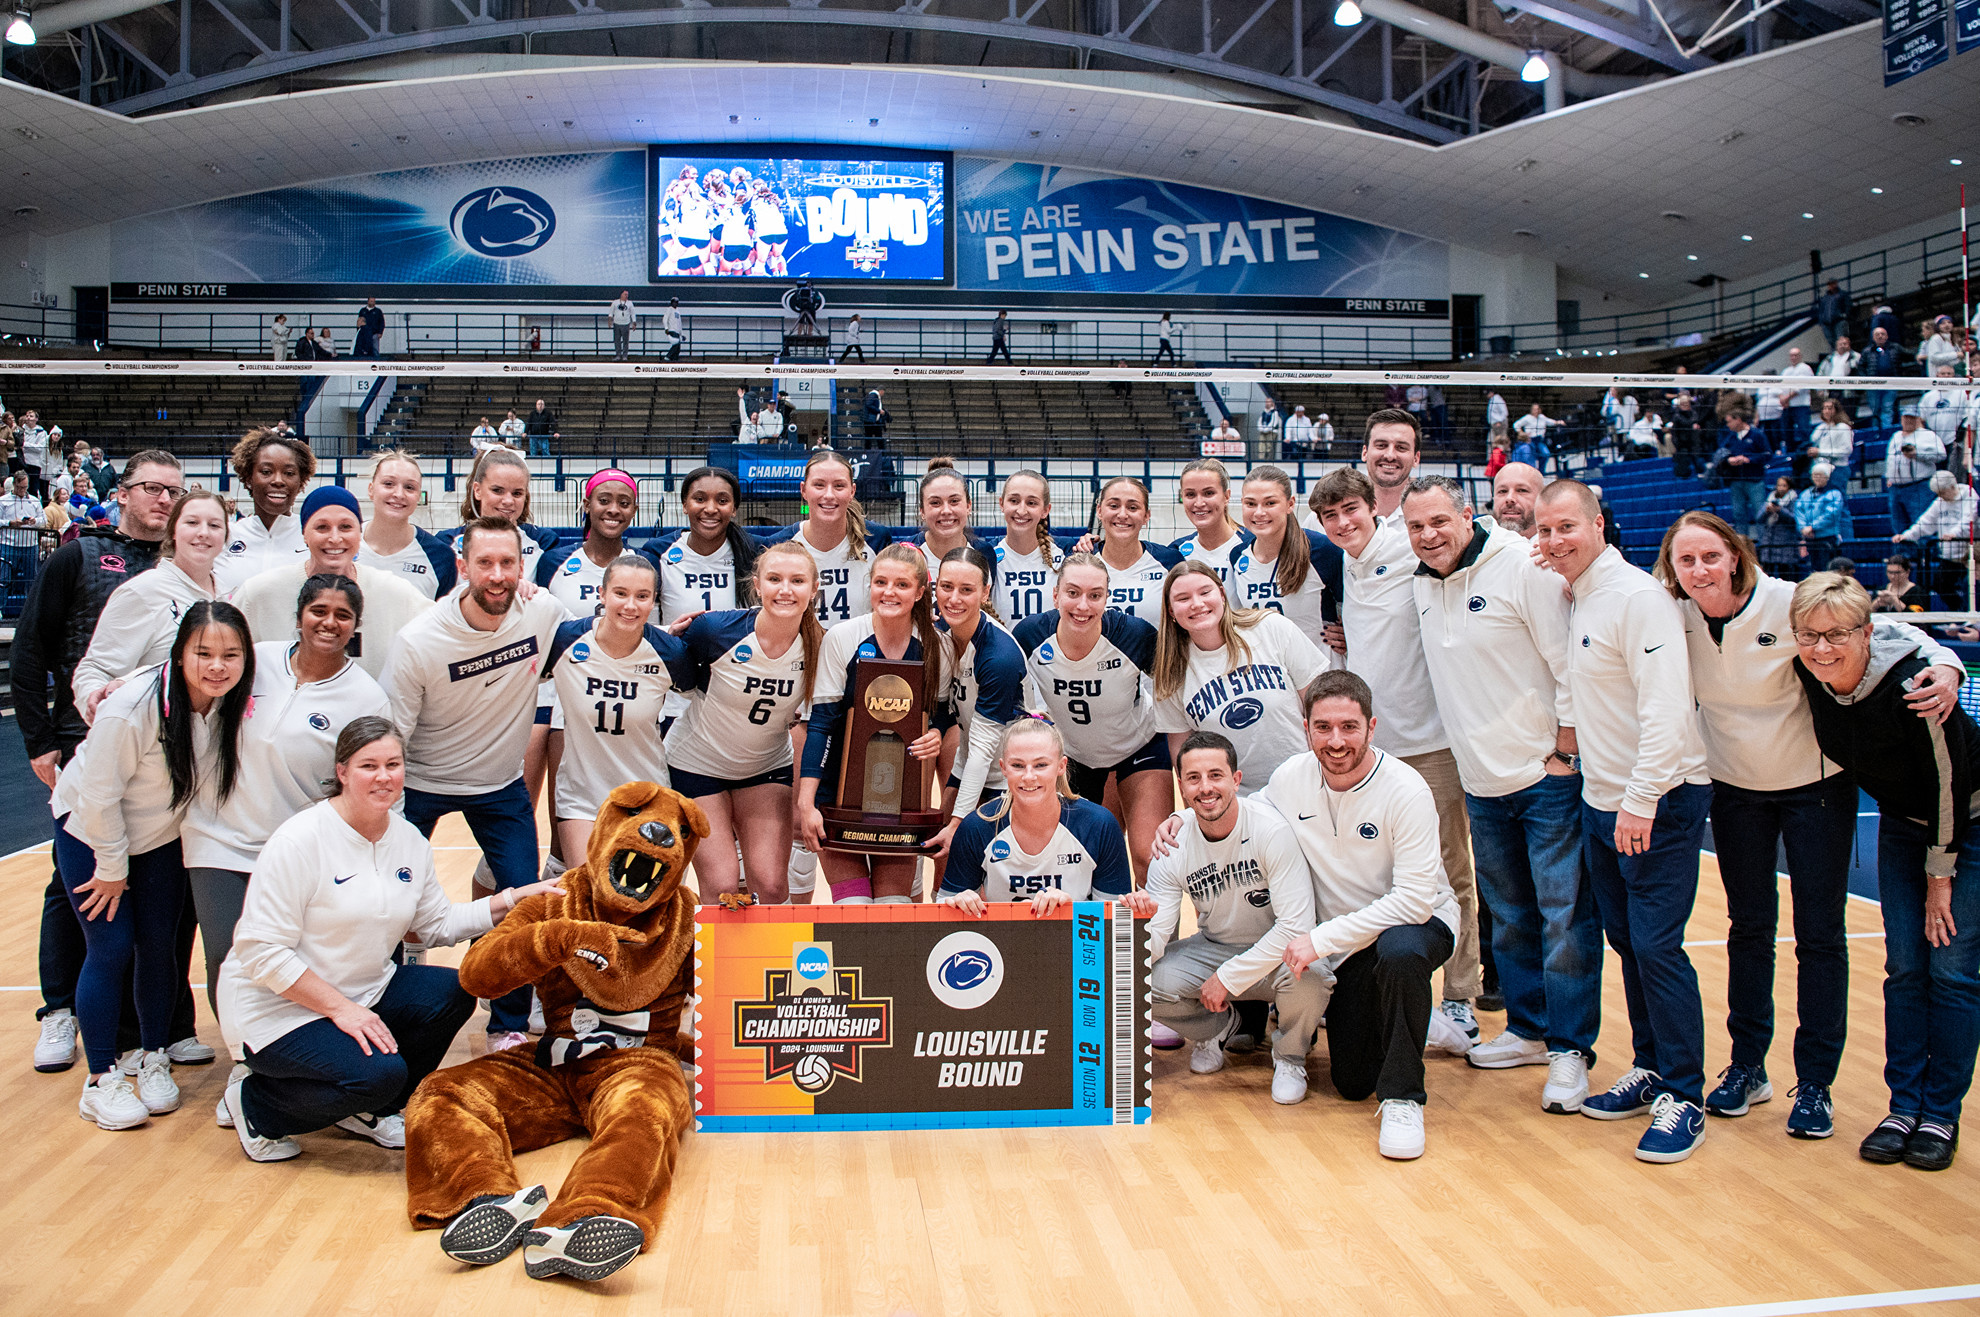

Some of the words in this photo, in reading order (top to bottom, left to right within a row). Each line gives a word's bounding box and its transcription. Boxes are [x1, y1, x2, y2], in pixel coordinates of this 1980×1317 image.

[1893, 39, 1938, 65] VOLLEYBALL
[822, 175, 910, 186] LOUISVILLE
[805, 187, 929, 246] BOUND
[963, 208, 1011, 234] WE
[1021, 204, 1082, 231] ARE
[985, 227, 1136, 281] PENN
[1153, 217, 1320, 270] STATE
[138, 284, 173, 296] PENN
[176, 284, 228, 296] STATE
[1346, 300, 1382, 311] PENN
[1385, 300, 1426, 312] STATE
[358, 381, 369, 390] E3
[799, 382, 810, 391] E2
[685, 574, 728, 588] PSU
[820, 569, 849, 586] SU
[1005, 571, 1046, 586] PSU
[814, 588, 850, 620] 44
[1010, 588, 1042, 620] 10
[458, 656, 493, 675] PENN
[494, 643, 531, 664] STATE
[1040, 649, 1052, 657] NCAA
[791, 661, 805, 671] B1
[586, 677, 638, 700] PSU
[743, 676, 794, 697] PSU
[1053, 679, 1102, 697] PSU
[1185, 678, 1228, 727] PENN
[1230, 664, 1286, 694] STATE
[749, 699, 775, 725] 6
[868, 697, 910, 712] NCAA
[1067, 700, 1092, 725] 9
[594, 700, 625, 735] 11
[820, 748, 829, 768] PENN
[842, 831, 876, 842] REGIONAL
[878, 833, 917, 844] CHAMPION
[1010, 874, 1062, 894] PSU
[1078, 914, 1100, 942] 24
[1083, 943, 1096, 966] SEAT
[800, 962, 828, 972] NCAA
[1079, 978, 1100, 1000] 19
[776, 1004, 848, 1018] VOLLEYBALL
[1083, 1004, 1096, 1027] ROW
[744, 1018, 880, 1038] CHAMPIONSHIP
[806, 1044, 844, 1052] LOUISVILLE
[914, 1030, 1048, 1057] LOUISVILLE
[1079, 1042, 1100, 1066] 12
[938, 1062, 1024, 1088] BOUND
[1083, 1067, 1096, 1109] SECTION
